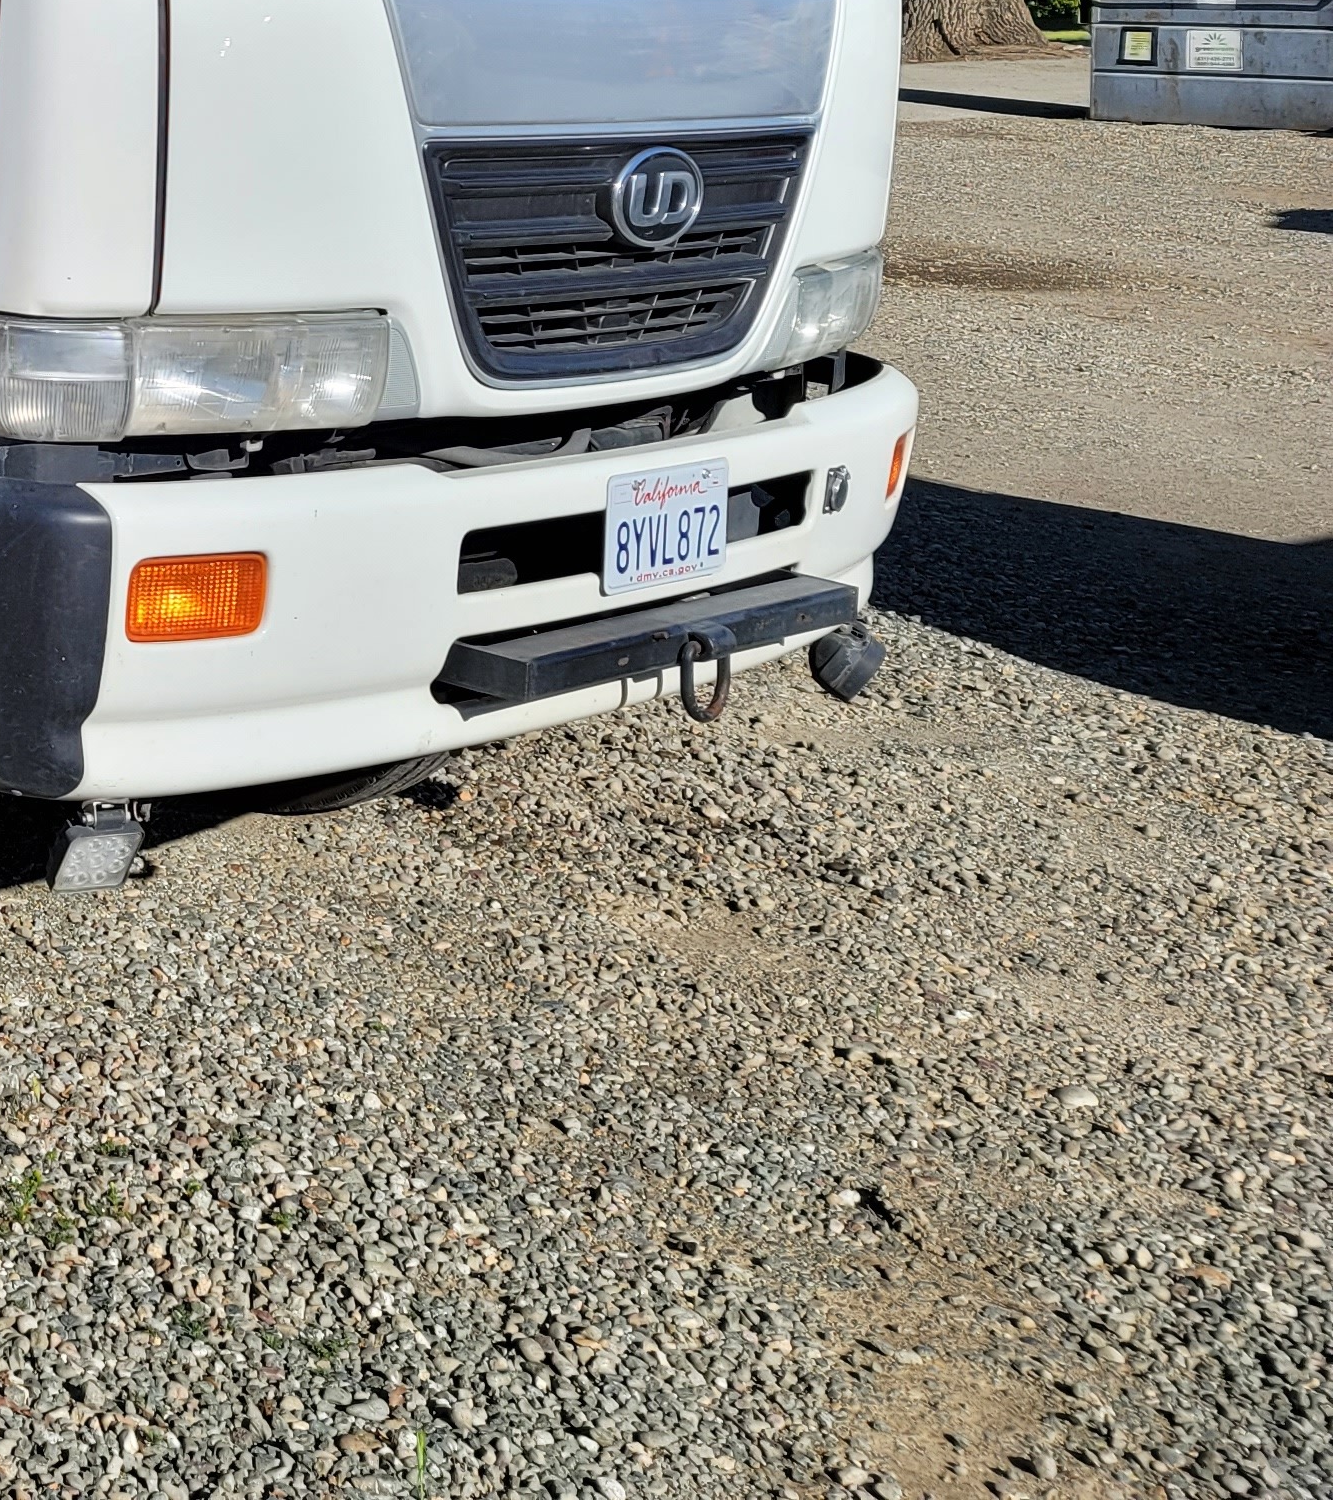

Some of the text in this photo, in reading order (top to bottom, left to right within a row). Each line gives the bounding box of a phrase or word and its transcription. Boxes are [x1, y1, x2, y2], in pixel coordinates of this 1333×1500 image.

[629, 170, 696, 227] UD
[633, 476, 708, 511] California
[616, 504, 720, 574] 8YVL872
[636, 563, 698, 583] dmv.ca.gov
